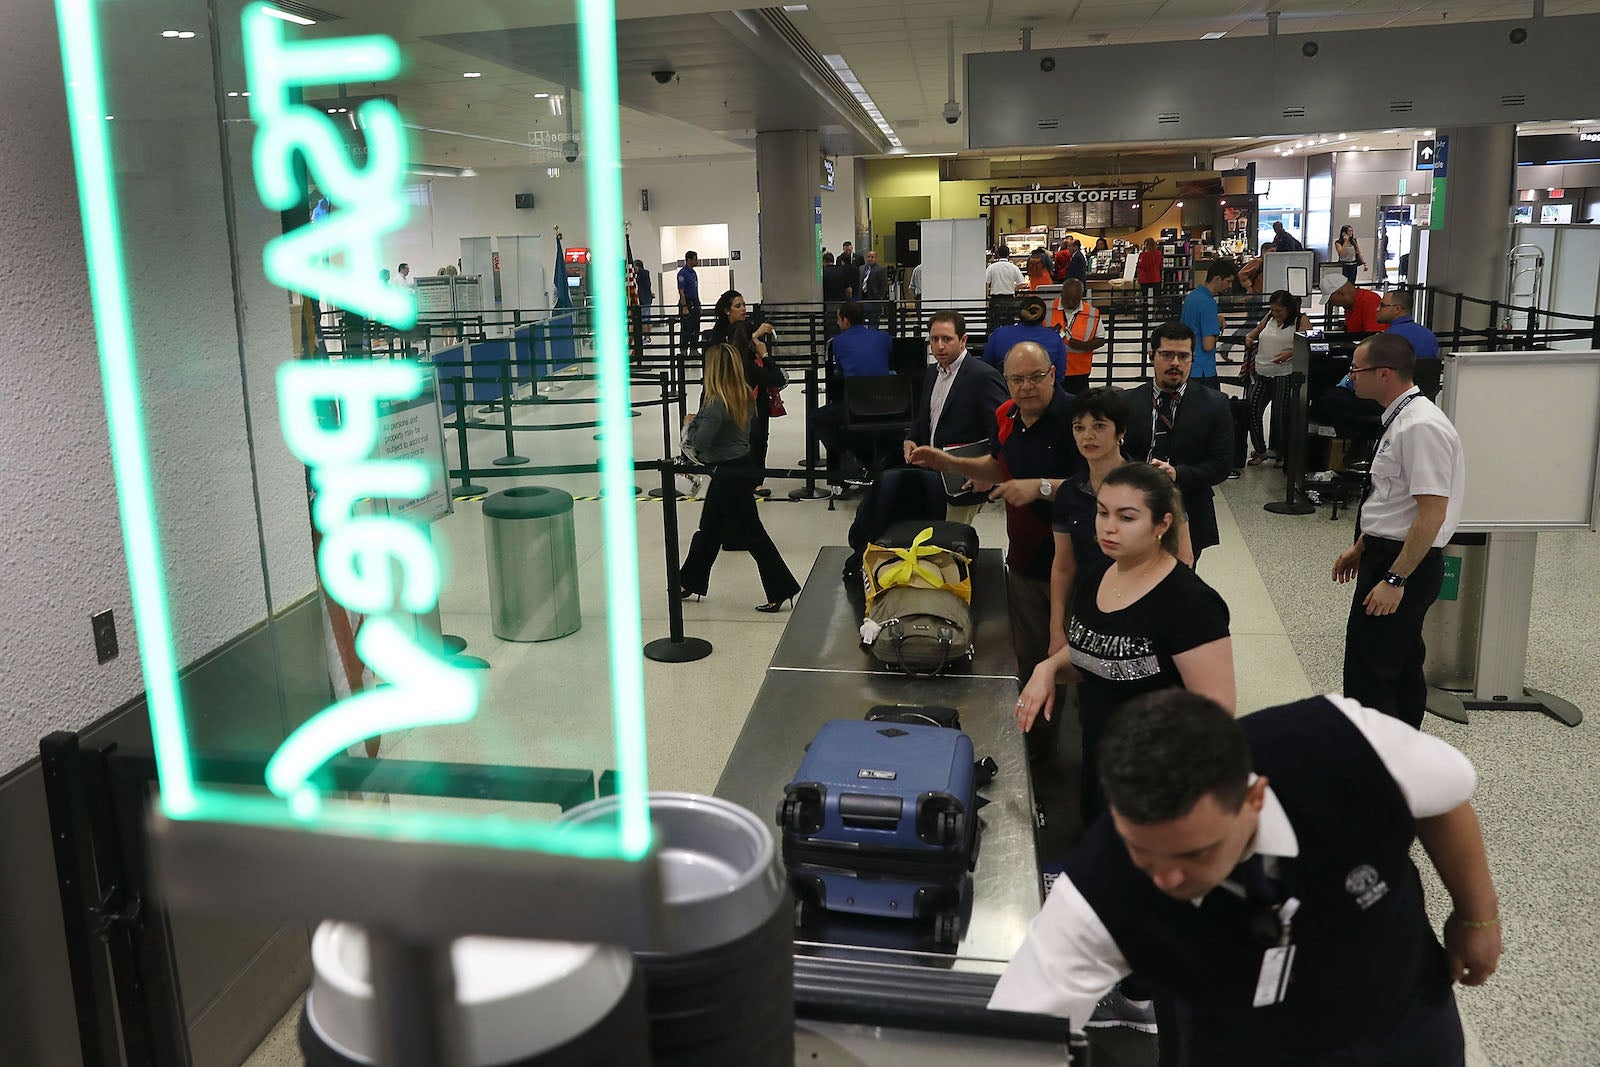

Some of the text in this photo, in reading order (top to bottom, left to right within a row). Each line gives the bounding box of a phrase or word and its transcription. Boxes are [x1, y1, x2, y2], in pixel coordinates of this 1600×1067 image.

[981, 189, 1137, 206] STARBUCKS COFFEE
[391, 419, 409, 431] persons
[410, 415, 418, 425] and
[385, 426, 421, 444] property may be
[386, 433, 429, 455] subject to additional
